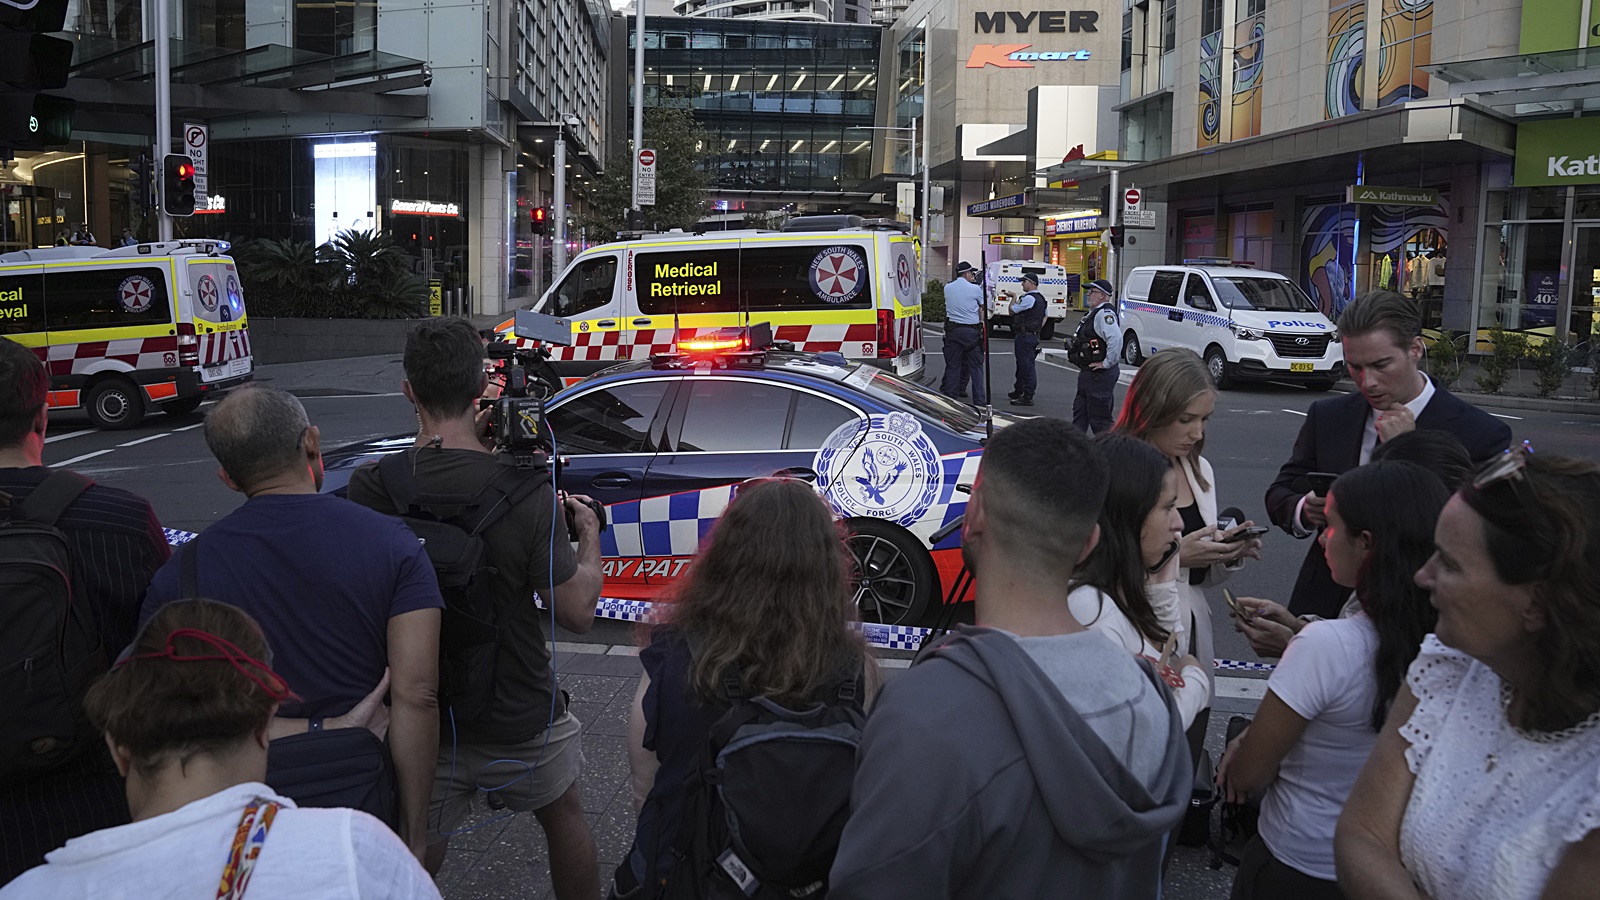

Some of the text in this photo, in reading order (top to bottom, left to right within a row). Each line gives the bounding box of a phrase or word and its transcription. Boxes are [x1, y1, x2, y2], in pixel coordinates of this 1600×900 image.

[975, 11, 1099, 33] MYER
[966, 44, 1091, 68] Kmart
[1379, 191, 1431, 202] Kathmandu
[392, 200, 458, 214] General Pants Co.
[972, 196, 1017, 213] CHEMIST WAREHOUSE
[1056, 220, 1073, 232] CHEMIST
[811, 246, 864, 270] NEW SOUTH WALES
[655, 261, 717, 278] Medical
[118, 281, 126, 291] NEW
[142, 276, 155, 291] WALES
[651, 280, 721, 297] Retrieval
[816, 290, 858, 303] AMBULANCE
[1534, 294, 1558, 304] 40%
[123, 303, 151, 313] AMBULANCE
[217, 323, 237, 332] Ambulance
[1267, 320, 1327, 329] Police
[849, 433, 922, 478] NEW SOUTH WALES
[835, 481, 857, 510] POLICE
[866, 507, 897, 517] FORCE
[601, 559, 693, 577] AY PAT
[604, 602, 643, 614] POLICE
[906, 635, 920, 643] PO
